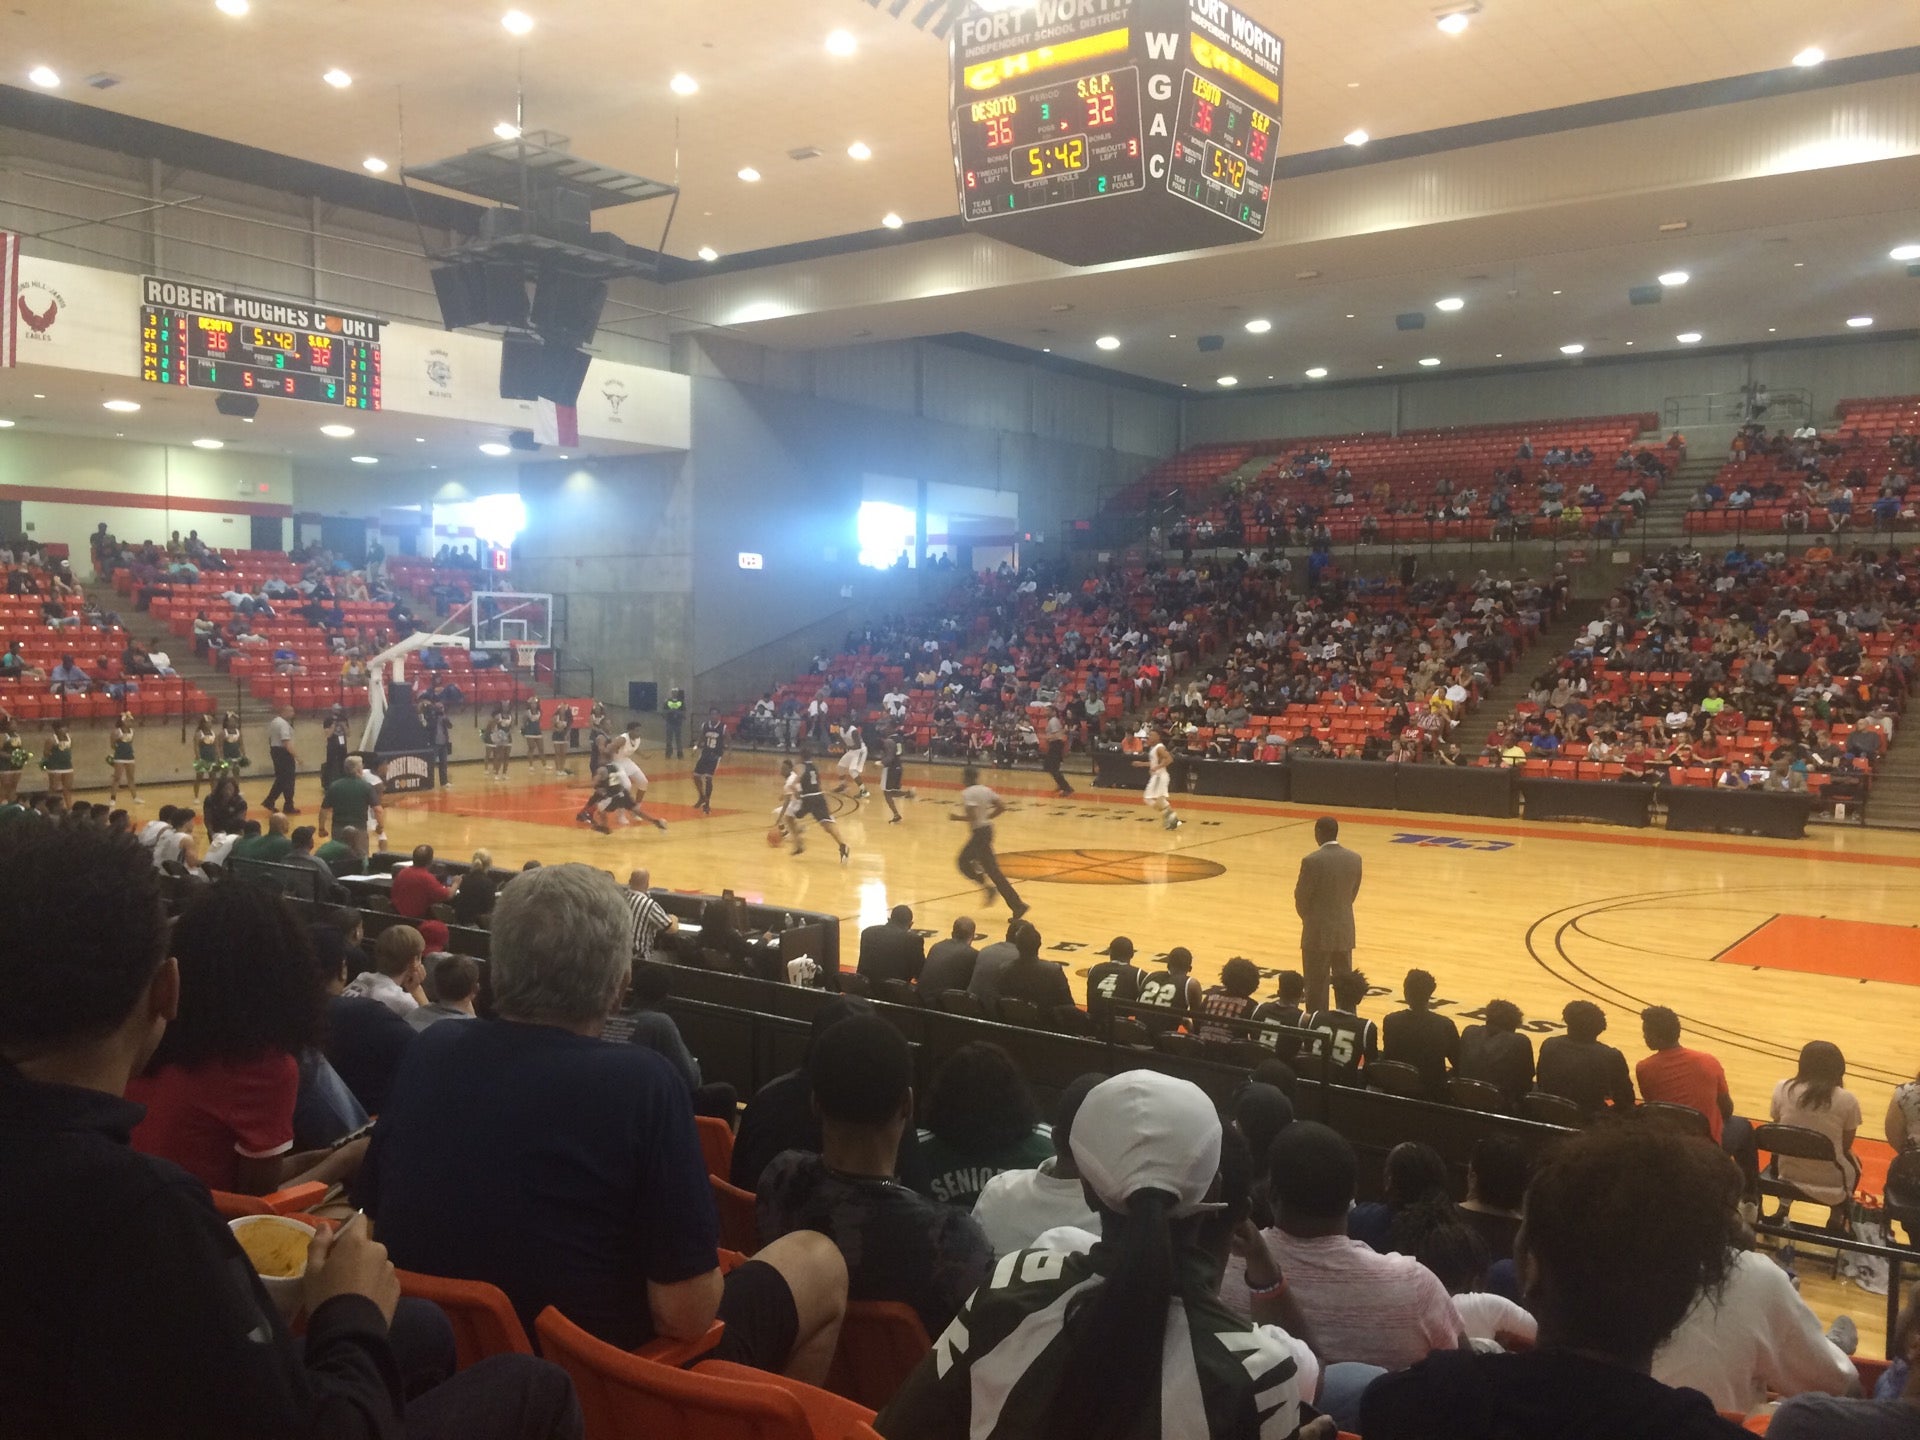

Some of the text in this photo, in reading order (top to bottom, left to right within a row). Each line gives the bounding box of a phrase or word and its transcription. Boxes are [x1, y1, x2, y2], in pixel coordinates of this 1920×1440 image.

[962, 8, 1024, 47] FORT
[965, 8, 1129, 59] INDEPENDENT SCHOOL DISTRICT
[1190, 10, 1231, 45] INDEPENDENT
[1231, 9, 1282, 66] WORTH
[971, 96, 1017, 123] DESOTO
[1041, 103, 1050, 120] 3
[1086, 94, 1115, 126] 32
[986, 117, 1014, 147] 36
[1128, 139, 1138, 156] 3
[1029, 139, 1083, 176] 5:42
[1112, 172, 1133, 182] TEAM
[1212, 149, 1244, 188] 5:42
[967, 171, 976, 188] 5
[1098, 176, 1107, 193] 2
[1112, 180, 1135, 190] FOULS
[973, 199, 991, 209] TEAM
[1008, 193, 1015, 209] 1
[972, 206, 993, 216] FOULS
[1242, 205, 1250, 221] 2
[148, 281, 225, 313] ROBERT
[233, 298, 309, 328] HUGHES
[150, 314, 157, 326] 3
[144, 327, 157, 340] 22
[208, 330, 228, 350] 36
[254, 327, 294, 351] 5:42
[144, 341, 157, 353] 23
[144, 355, 157, 367] 24
[275, 353, 285, 369] 3
[312, 347, 332, 367] 32
[144, 369, 157, 381] 25
[211, 367, 216, 383] 1
[243, 371, 254, 388] 5
[285, 377, 295, 393] 3
[327, 383, 336, 399] 2
[345, 396, 357, 407] 23
[1097, 973, 1119, 999] 4
[1139, 980, 1177, 1008] 22
